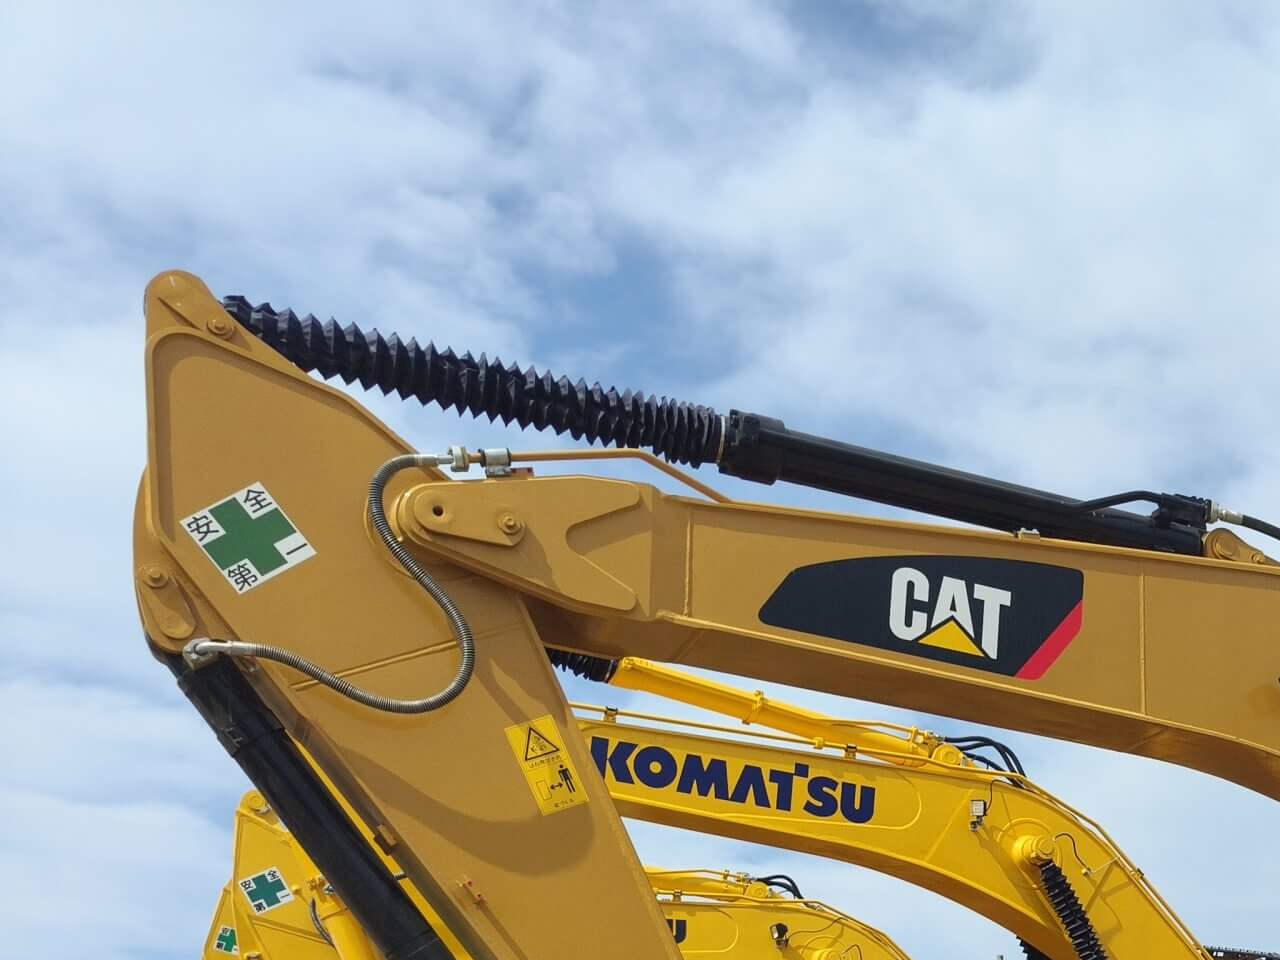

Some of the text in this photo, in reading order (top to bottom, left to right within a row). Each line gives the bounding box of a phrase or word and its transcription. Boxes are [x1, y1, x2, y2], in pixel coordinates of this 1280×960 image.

[187, 489, 273, 541] 安 全
[227, 563, 258, 591] 第
[889, 567, 1011, 660] CAT
[590, 736, 876, 823] KOMATSU
